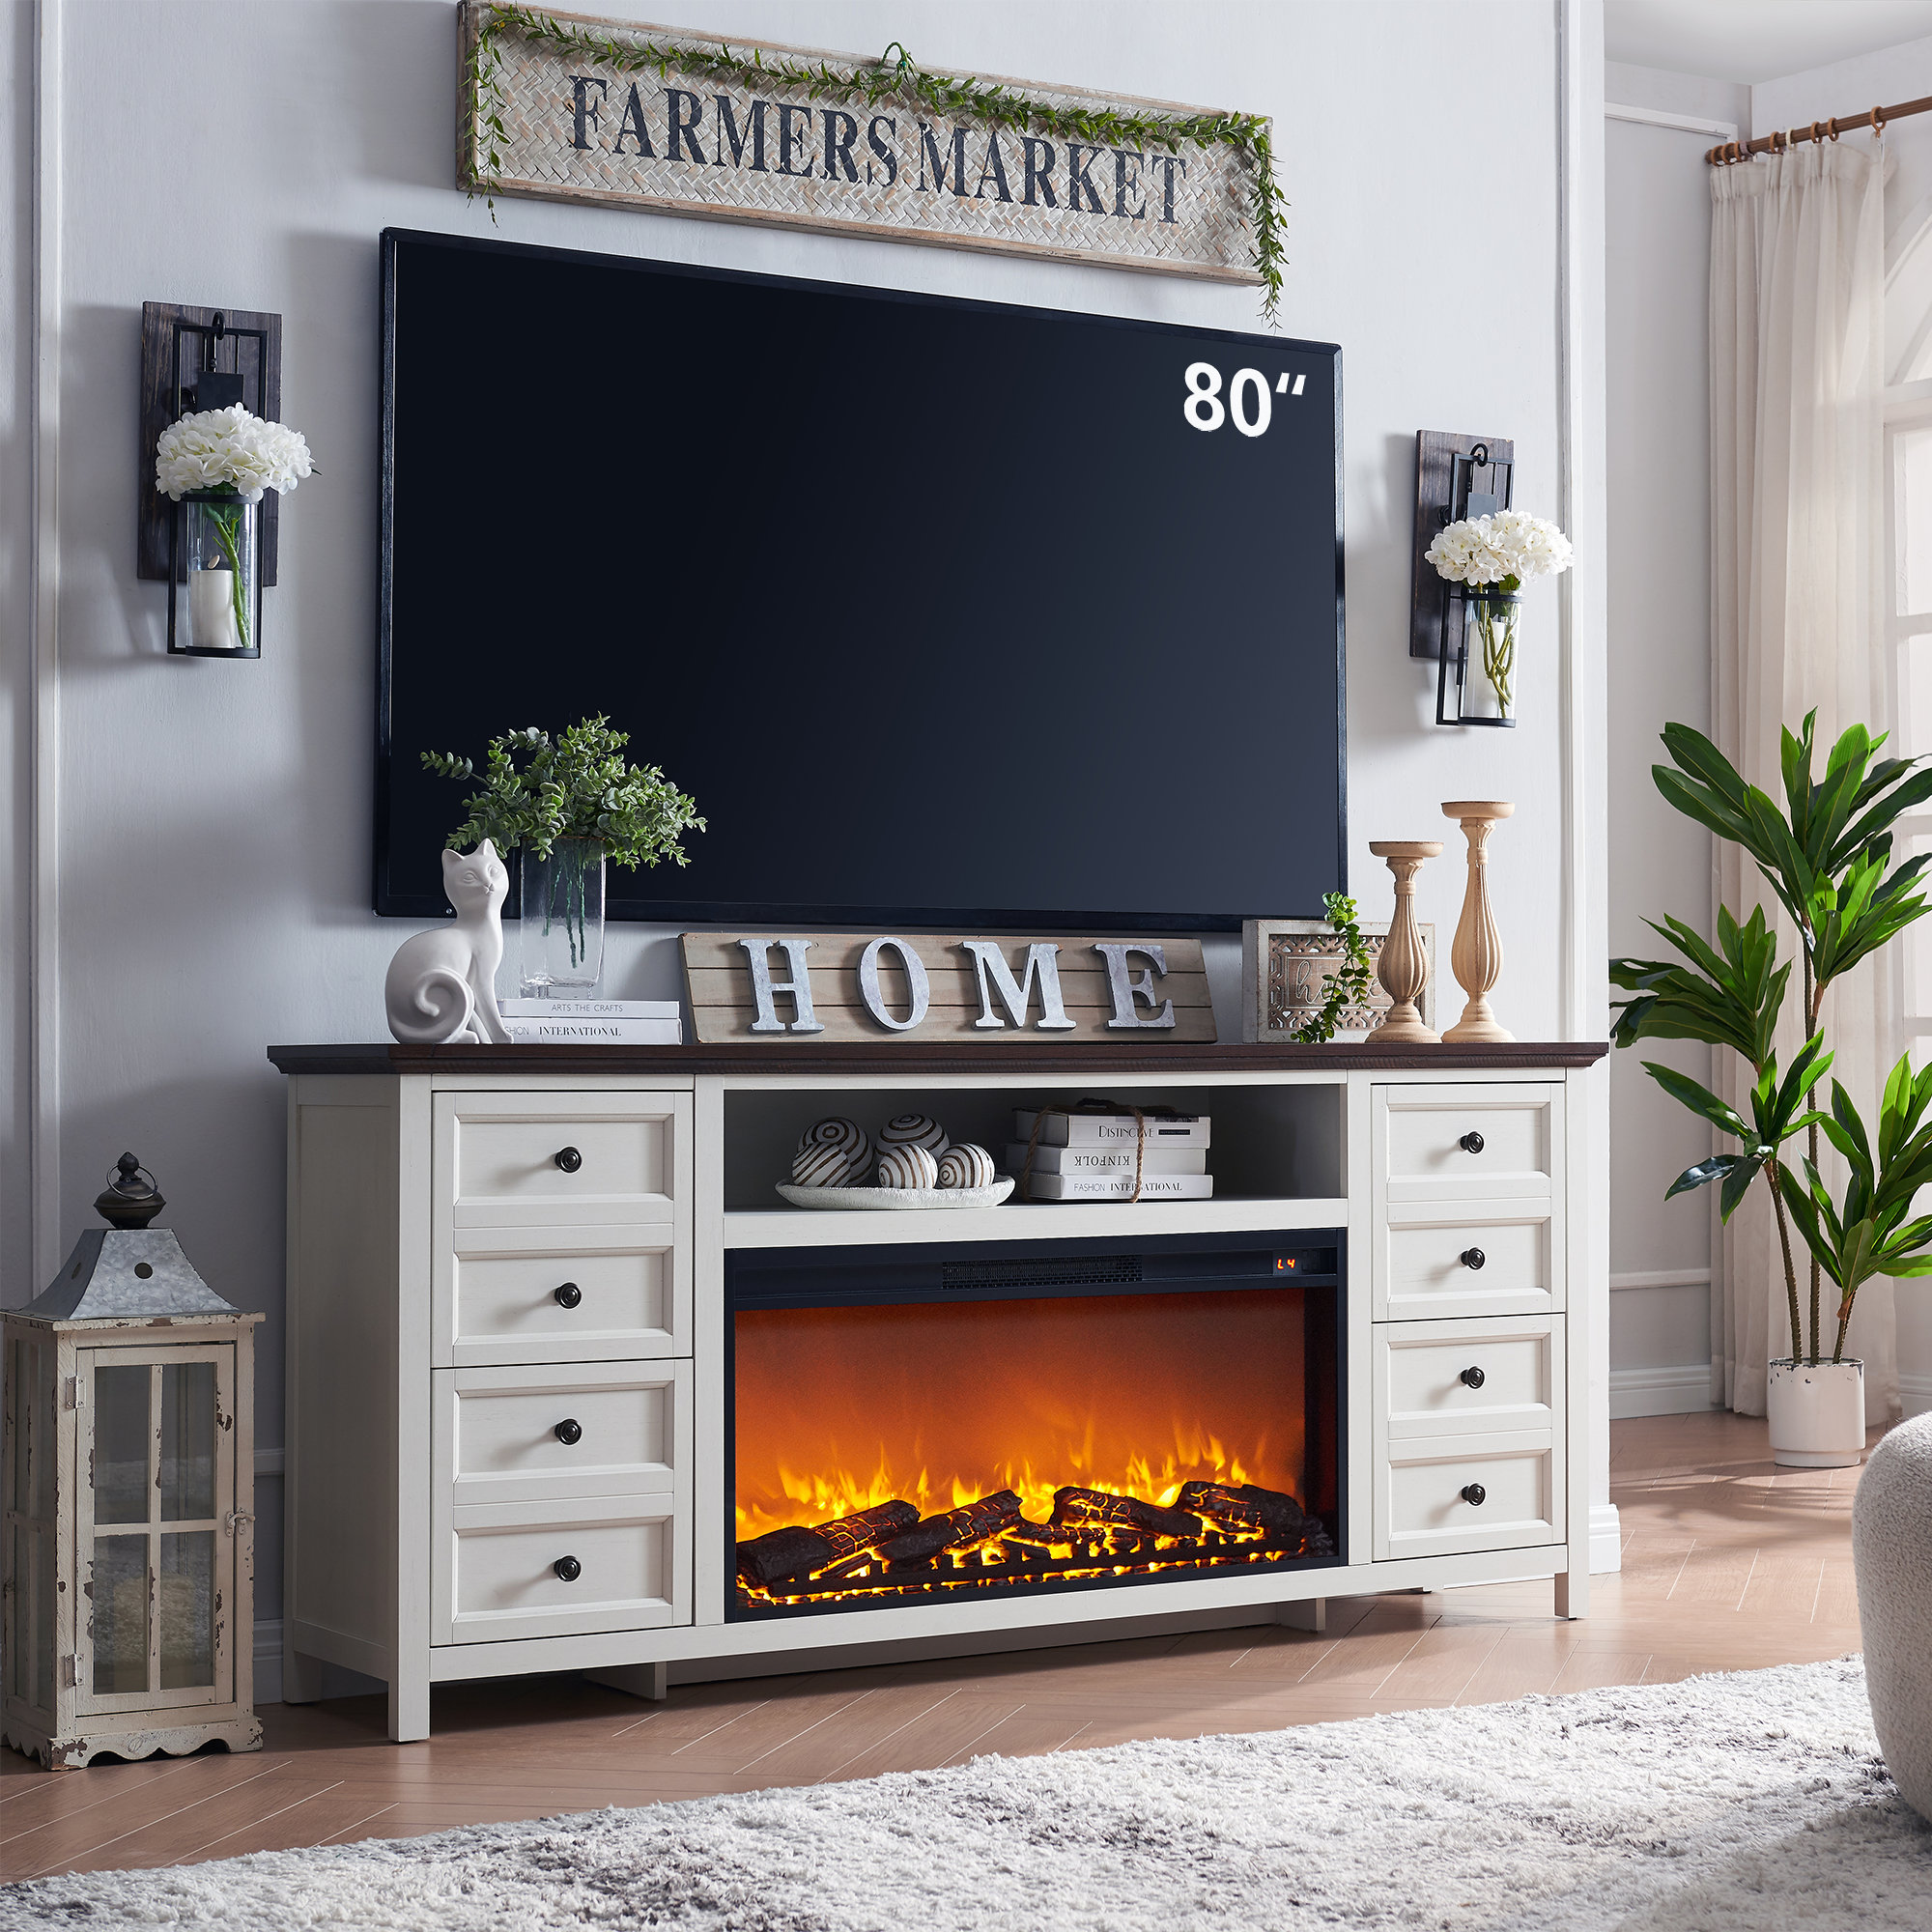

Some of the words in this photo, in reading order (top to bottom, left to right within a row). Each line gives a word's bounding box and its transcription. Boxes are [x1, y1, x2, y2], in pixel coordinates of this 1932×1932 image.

[568, 74, 897, 188] FARMERS
[916, 122, 1186, 224] MARKET
[734, 936, 1177, 1032] HOME
[552, 1004, 571, 1012] ARTS
[576, 1004, 590, 1012] THE
[594, 1004, 623, 1012] CRAFTS
[504, 1026, 529, 1036] SHION
[539, 1026, 622, 1037] INTERNATIONAL
[1098, 1125, 1154, 1138] DISTINCTVE
[1074, 1155, 1130, 1166] KINFOLK
[1073, 1182, 1105, 1192] FASHION
[1110, 1181, 1182, 1192] INTERATIONAL
